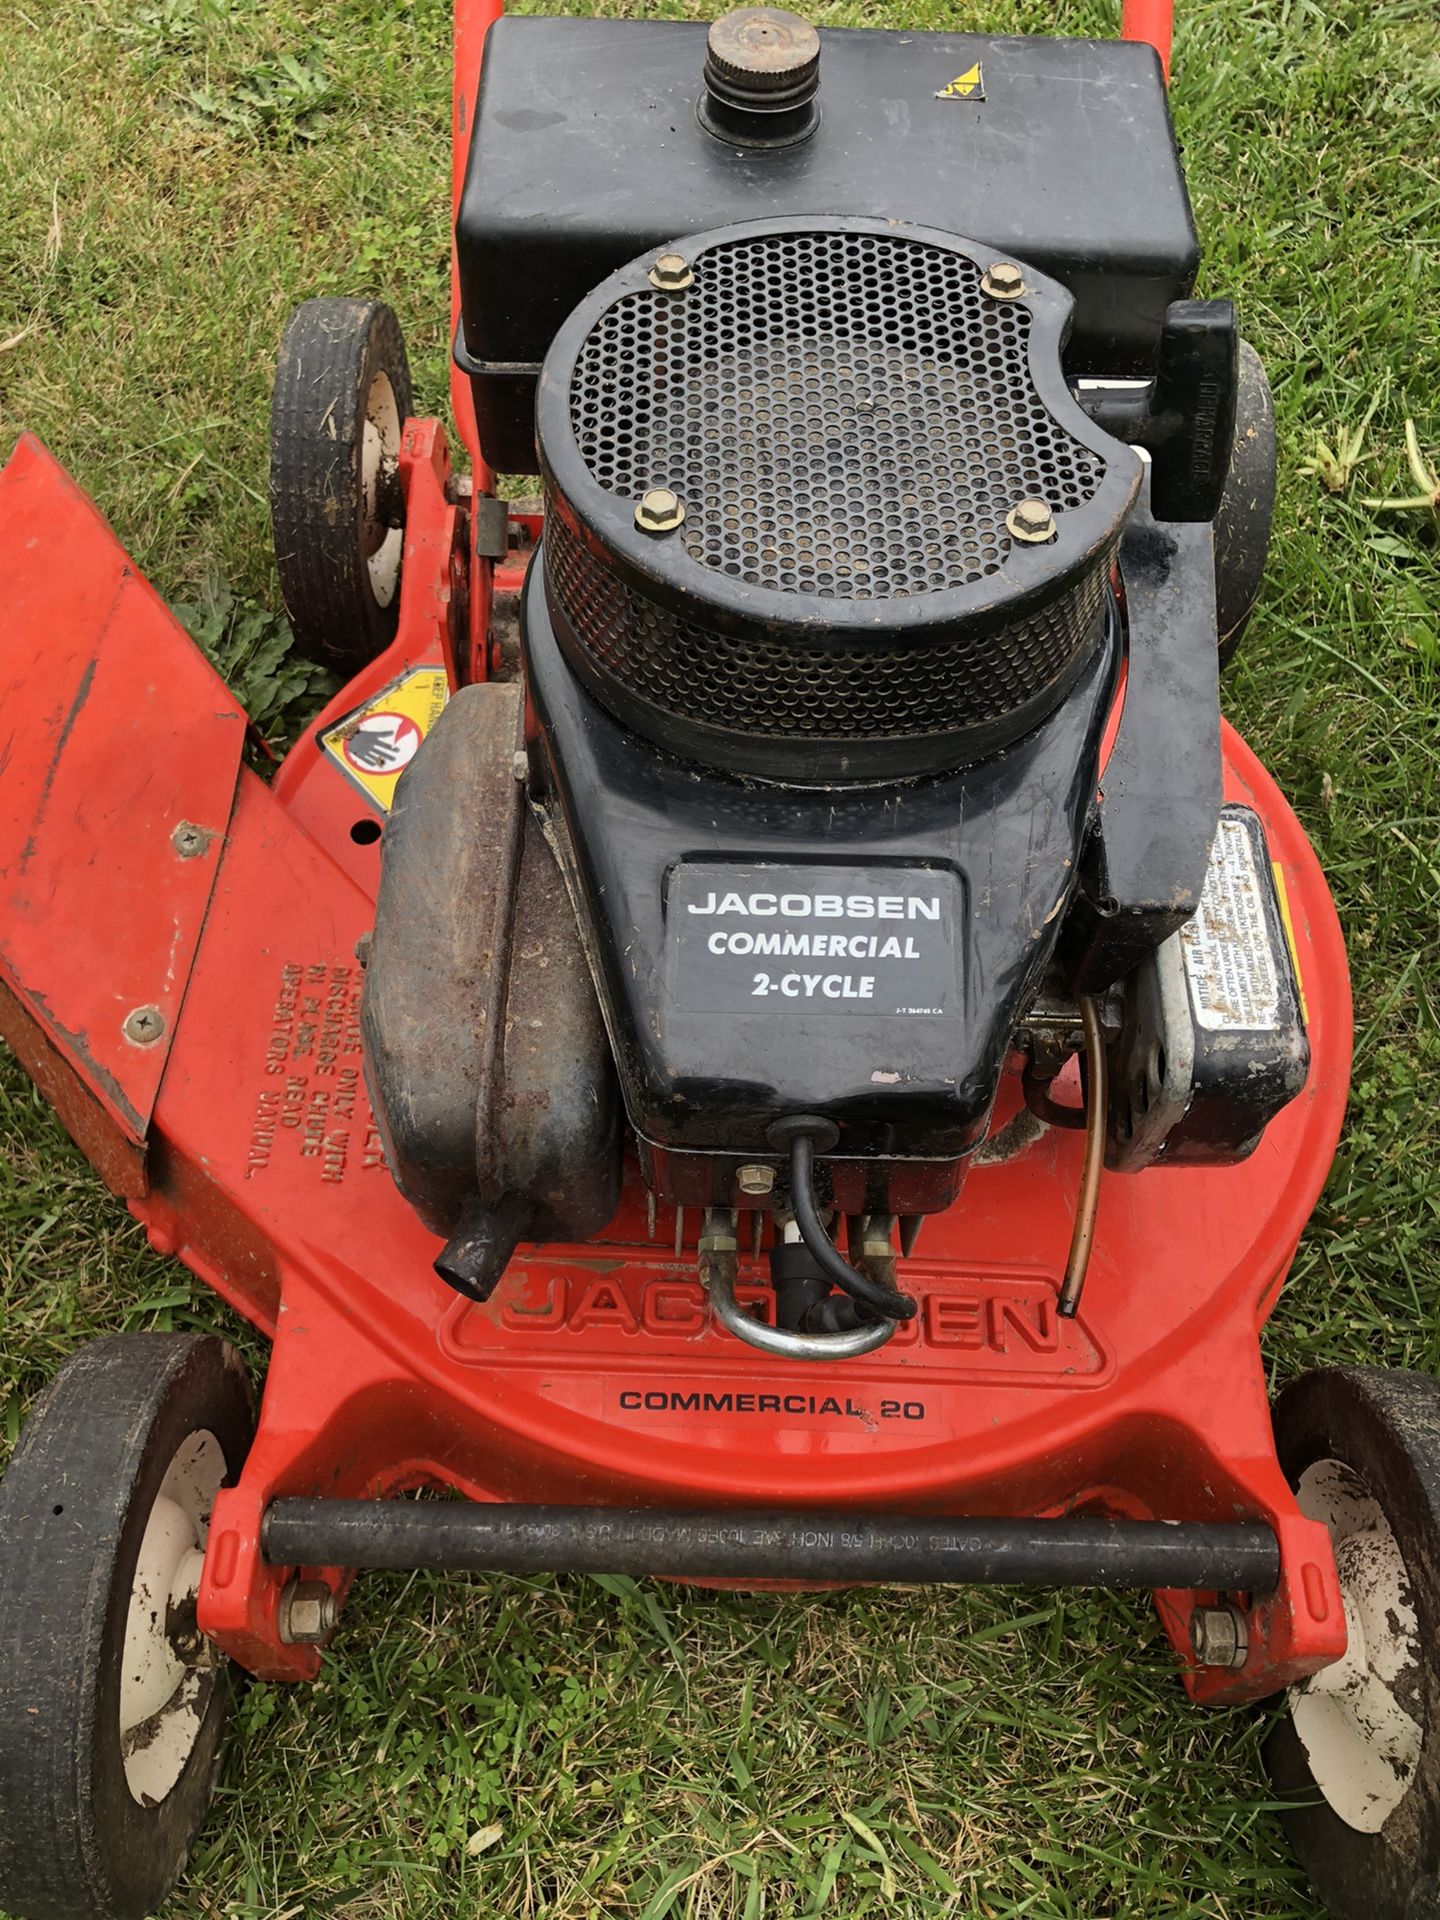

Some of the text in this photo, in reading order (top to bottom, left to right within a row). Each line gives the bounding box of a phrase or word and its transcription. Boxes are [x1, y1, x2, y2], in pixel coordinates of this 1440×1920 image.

[428, 677, 445, 730] KEEP HAN
[1221, 829, 1234, 854] ENGIN
[1241, 874, 1251, 891] ND
[688, 892, 940, 920] JACOBSEN
[1245, 895, 1254, 908] OIL
[1213, 907, 1226, 935] DSTY
[1224, 907, 1239, 947] KESENE
[1249, 912, 1258, 927] THE
[707, 931, 921, 959] COMMERCIAL
[1192, 949, 1204, 964] AIR
[1218, 937, 1232, 965] UNDER
[1244, 946, 1256, 971] MIXED
[1232, 950, 1243, 969] WITH
[751, 973, 875, 998] 2-CYCLE
[1214, 974, 1225, 991] AND
[1224, 968, 1238, 997] OFTEN
[1237, 971, 1251, 1006] ELEMENT
[1249, 973, 1260, 995] WITH
[1256, 954, 1272, 995] SQUEEZE
[264, 963, 303, 1076] OPERATORS
[1217, 995, 1231, 1023] CLN
[301, 966, 352, 1158] DISCHARGE CHUTE
[280, 1076, 309, 1130] READ
[333, 1068, 360, 1121] ONLY
[320, 1129, 350, 1184] WITH
[503, 1277, 1059, 1353] JACEN
[618, 1390, 926, 1421] COMMERCIAL 20
[792, 1532, 834, 1548] INCH
[841, 1533, 863, 1548] 5/8
